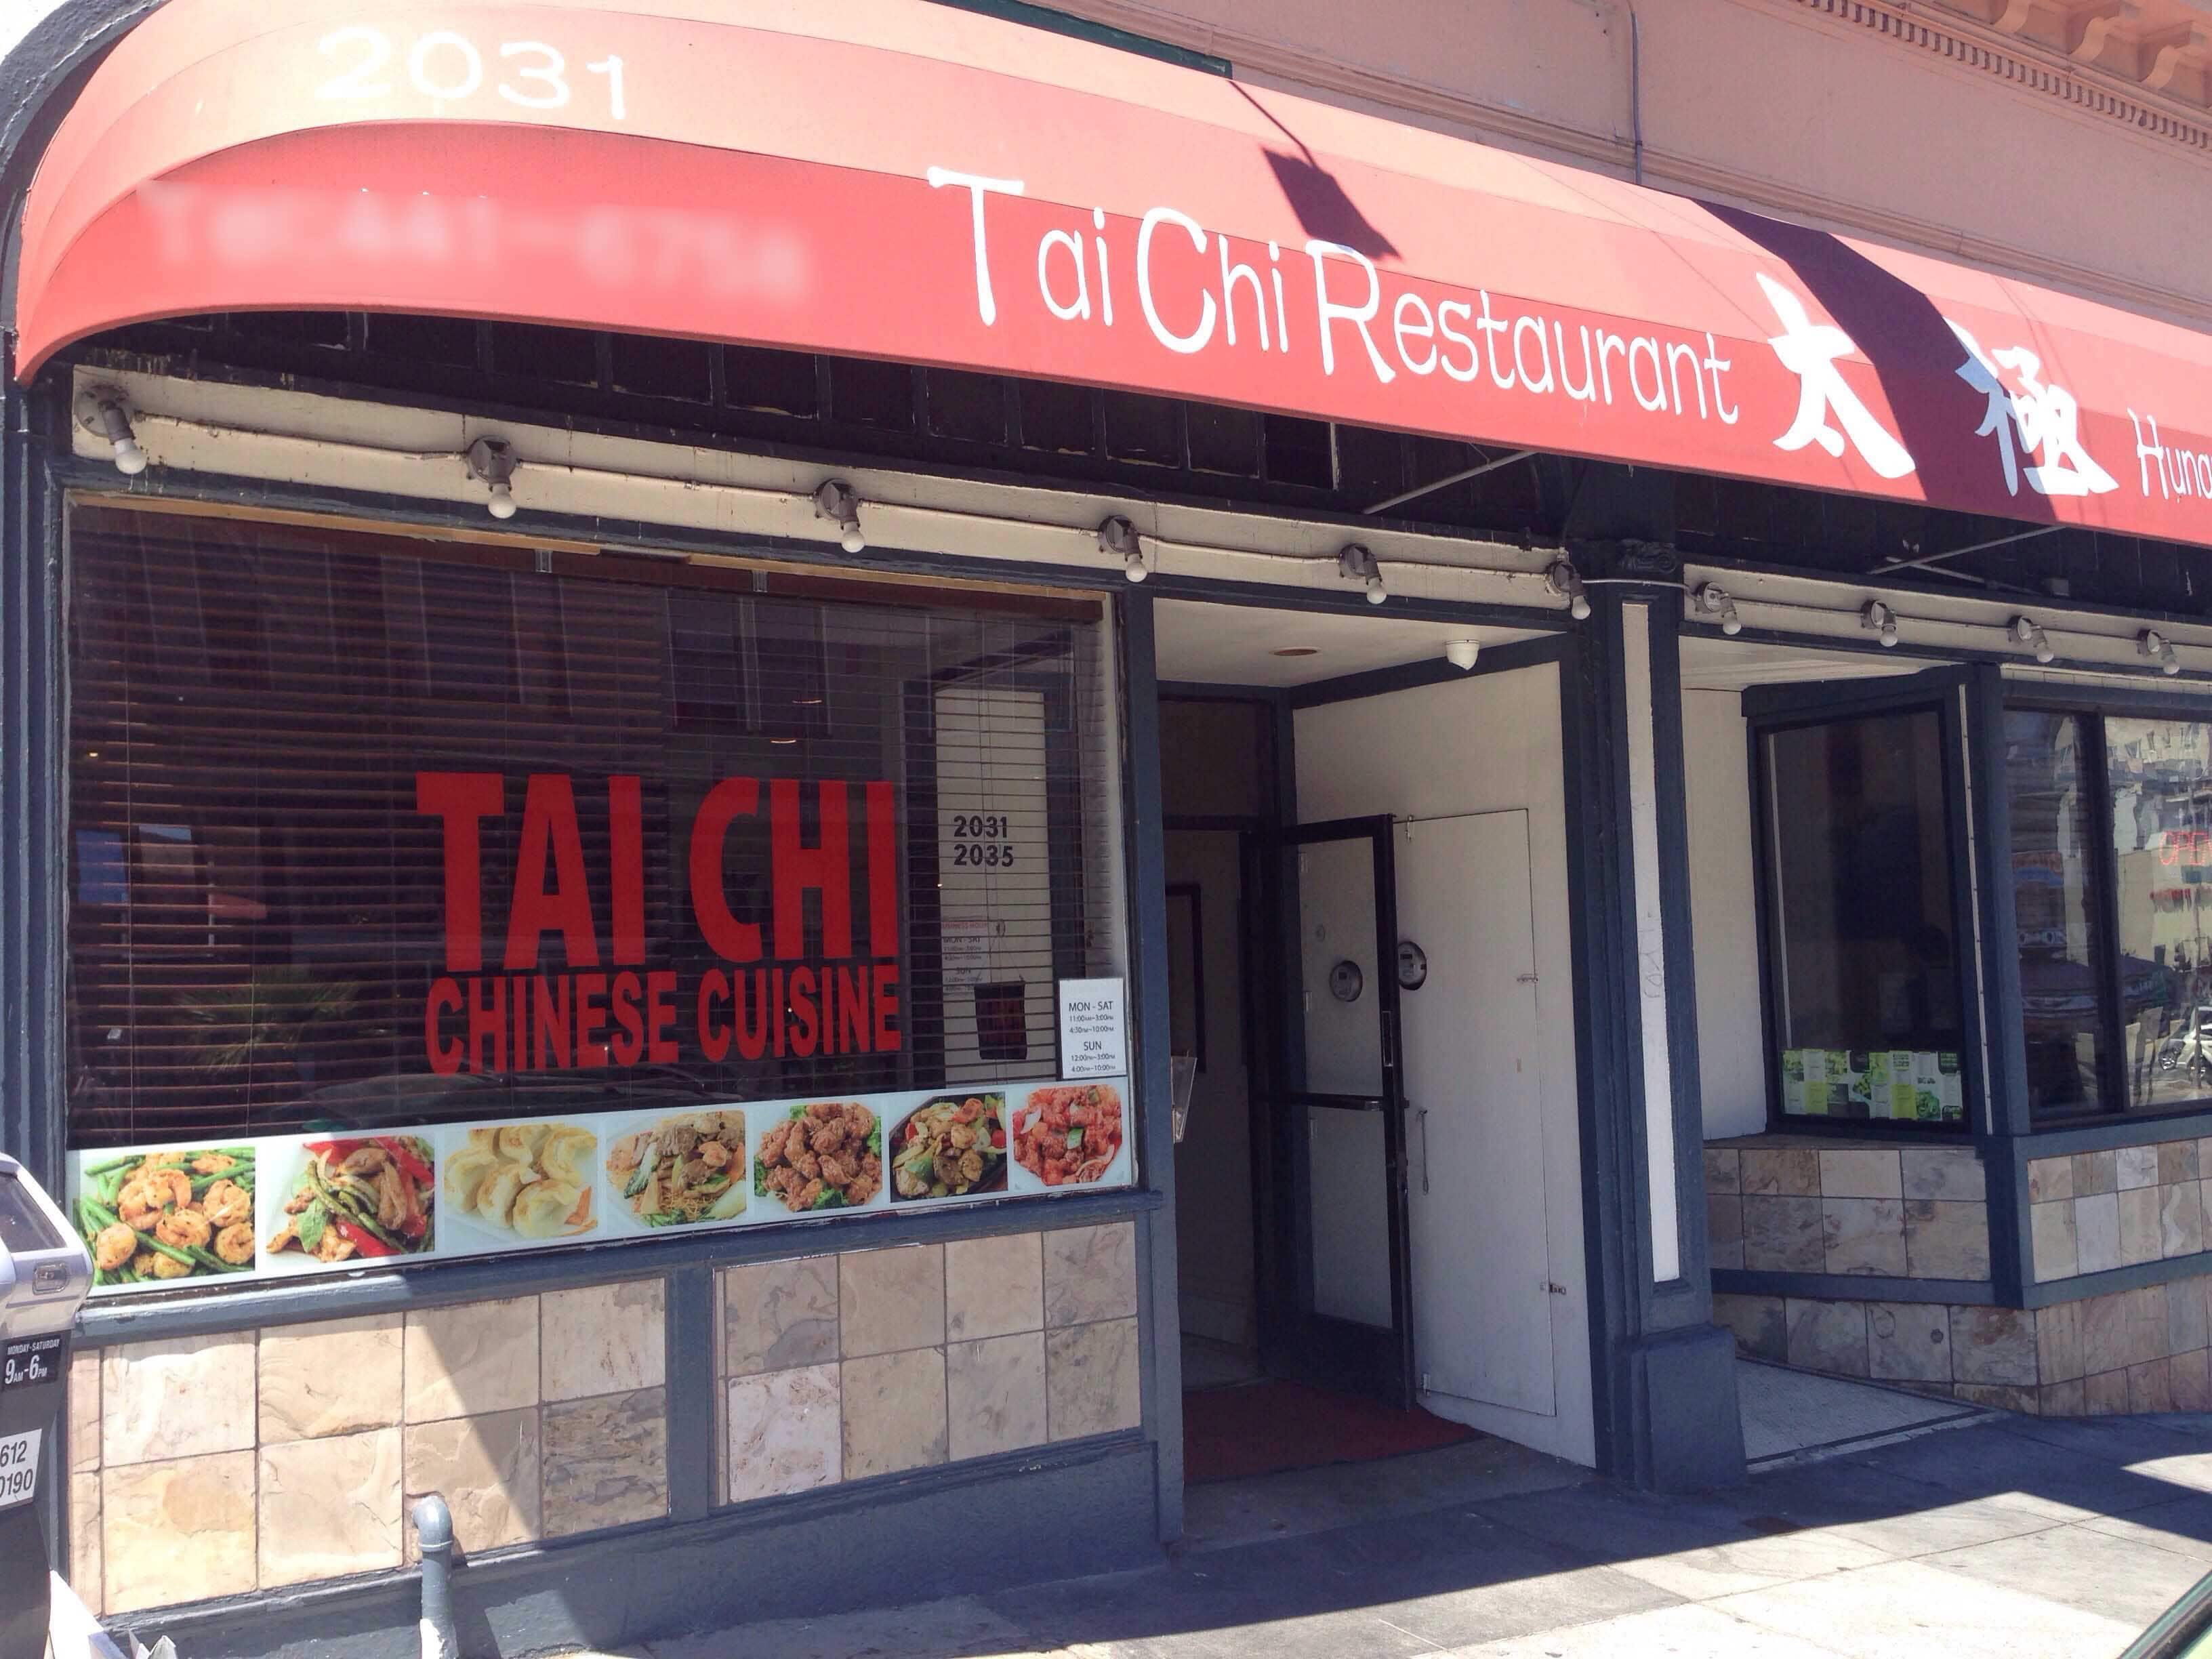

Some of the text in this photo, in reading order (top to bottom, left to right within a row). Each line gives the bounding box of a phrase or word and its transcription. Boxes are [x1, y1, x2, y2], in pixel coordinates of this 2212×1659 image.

[312, 26, 627, 120] 2031
[927, 166, 1113, 326] Tai
[1136, 207, 1289, 354] Chi
[1305, 240, 1740, 425] Restaurant
[954, 815, 1007, 838] 2031
[954, 844, 1014, 867] 2035
[415, 772, 899, 972] TAI CHI
[1069, 1002, 1090, 1012] MON
[1098, 1000, 1113, 1010] SAT
[425, 964, 901, 1078] CHINESE CUISINE
[1084, 1041, 1101, 1051] SUN
[0, 1440, 28, 1468] 612
